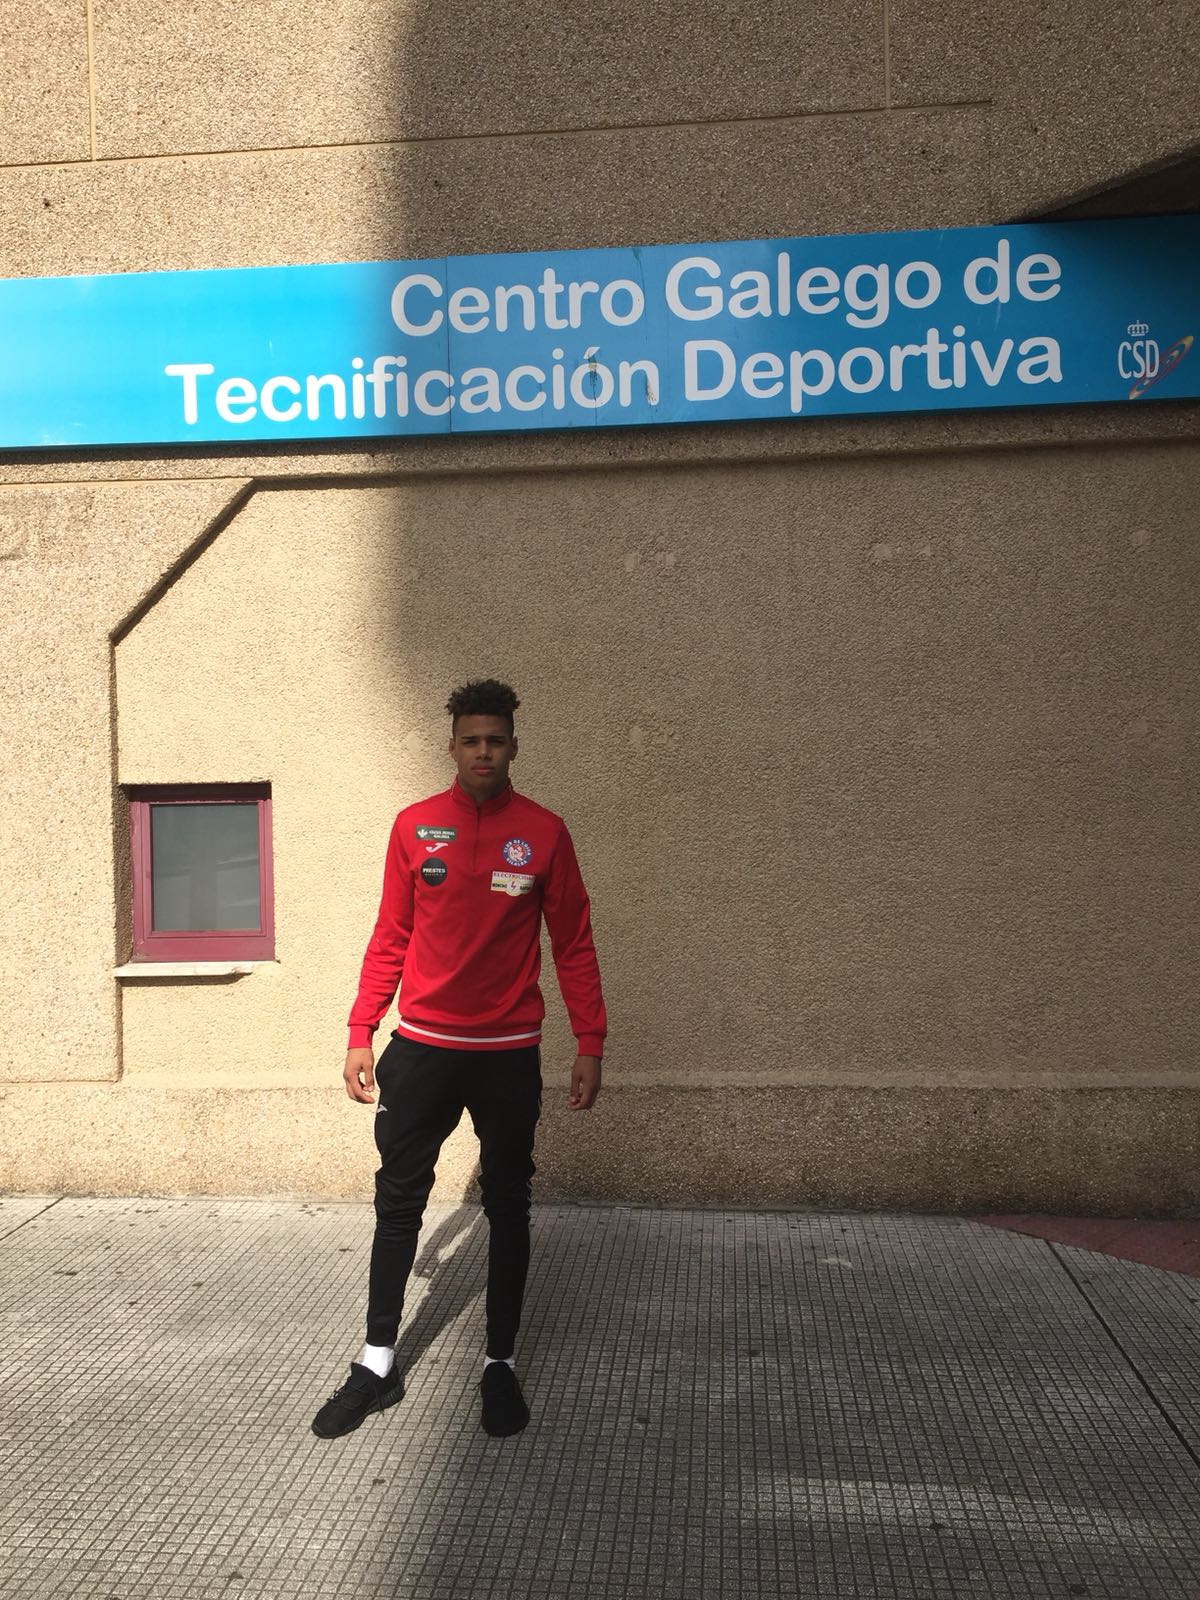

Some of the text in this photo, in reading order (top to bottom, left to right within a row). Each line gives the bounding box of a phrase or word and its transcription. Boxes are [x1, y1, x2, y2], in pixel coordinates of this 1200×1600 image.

[391, 239, 1062, 336] Centro Galego de
[165, 325, 1063, 424] Tecnificación Deportiva
[1117, 339, 1160, 379] CSD
